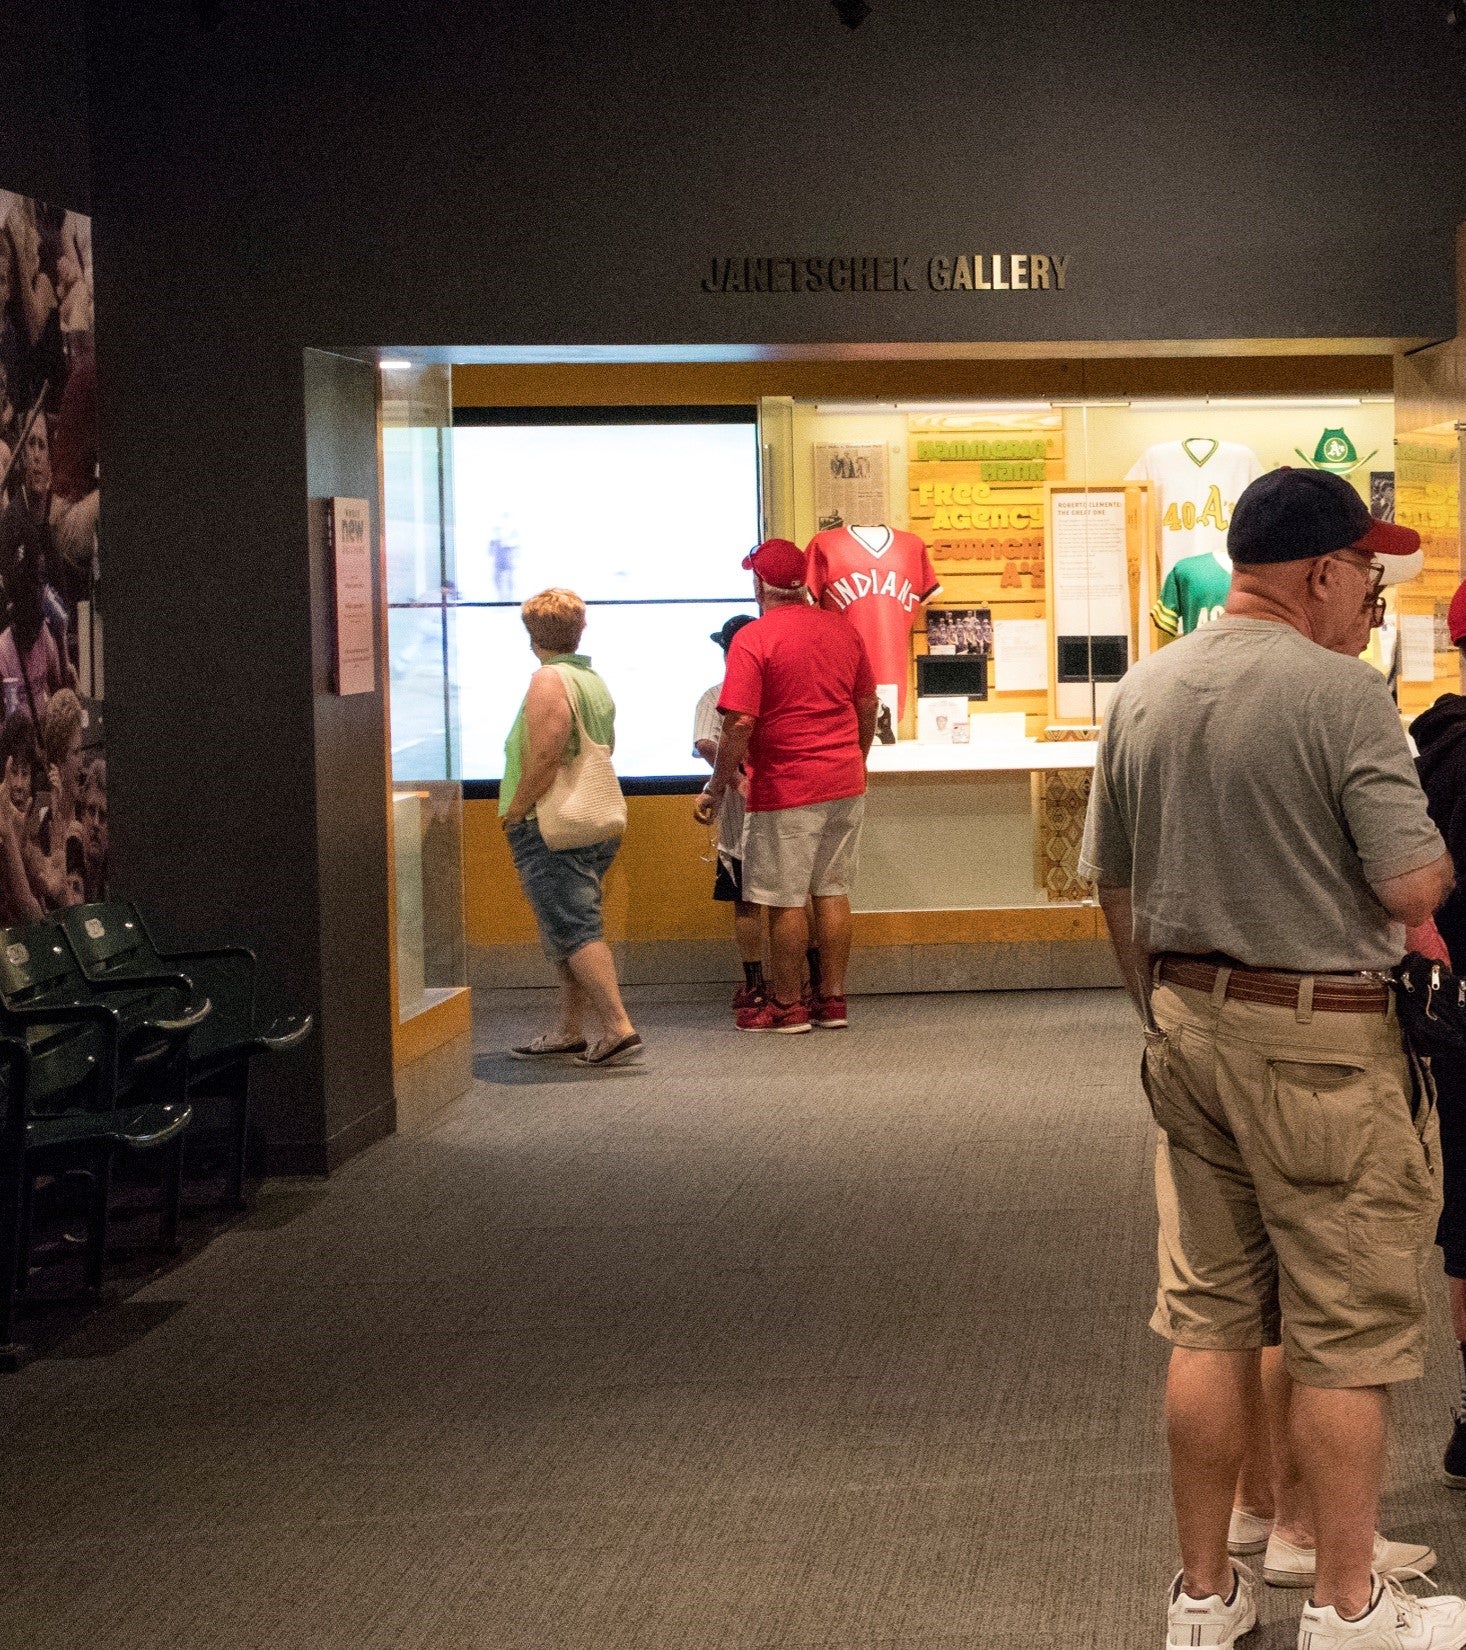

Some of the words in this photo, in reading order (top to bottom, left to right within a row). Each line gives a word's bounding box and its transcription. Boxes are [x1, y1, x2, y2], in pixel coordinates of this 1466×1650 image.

[701, 256, 917, 293] JANETSCHEK
[920, 253, 1070, 291] GALLERY
[1163, 502, 1197, 531] 40
[825, 568, 921, 613] INDIANS
